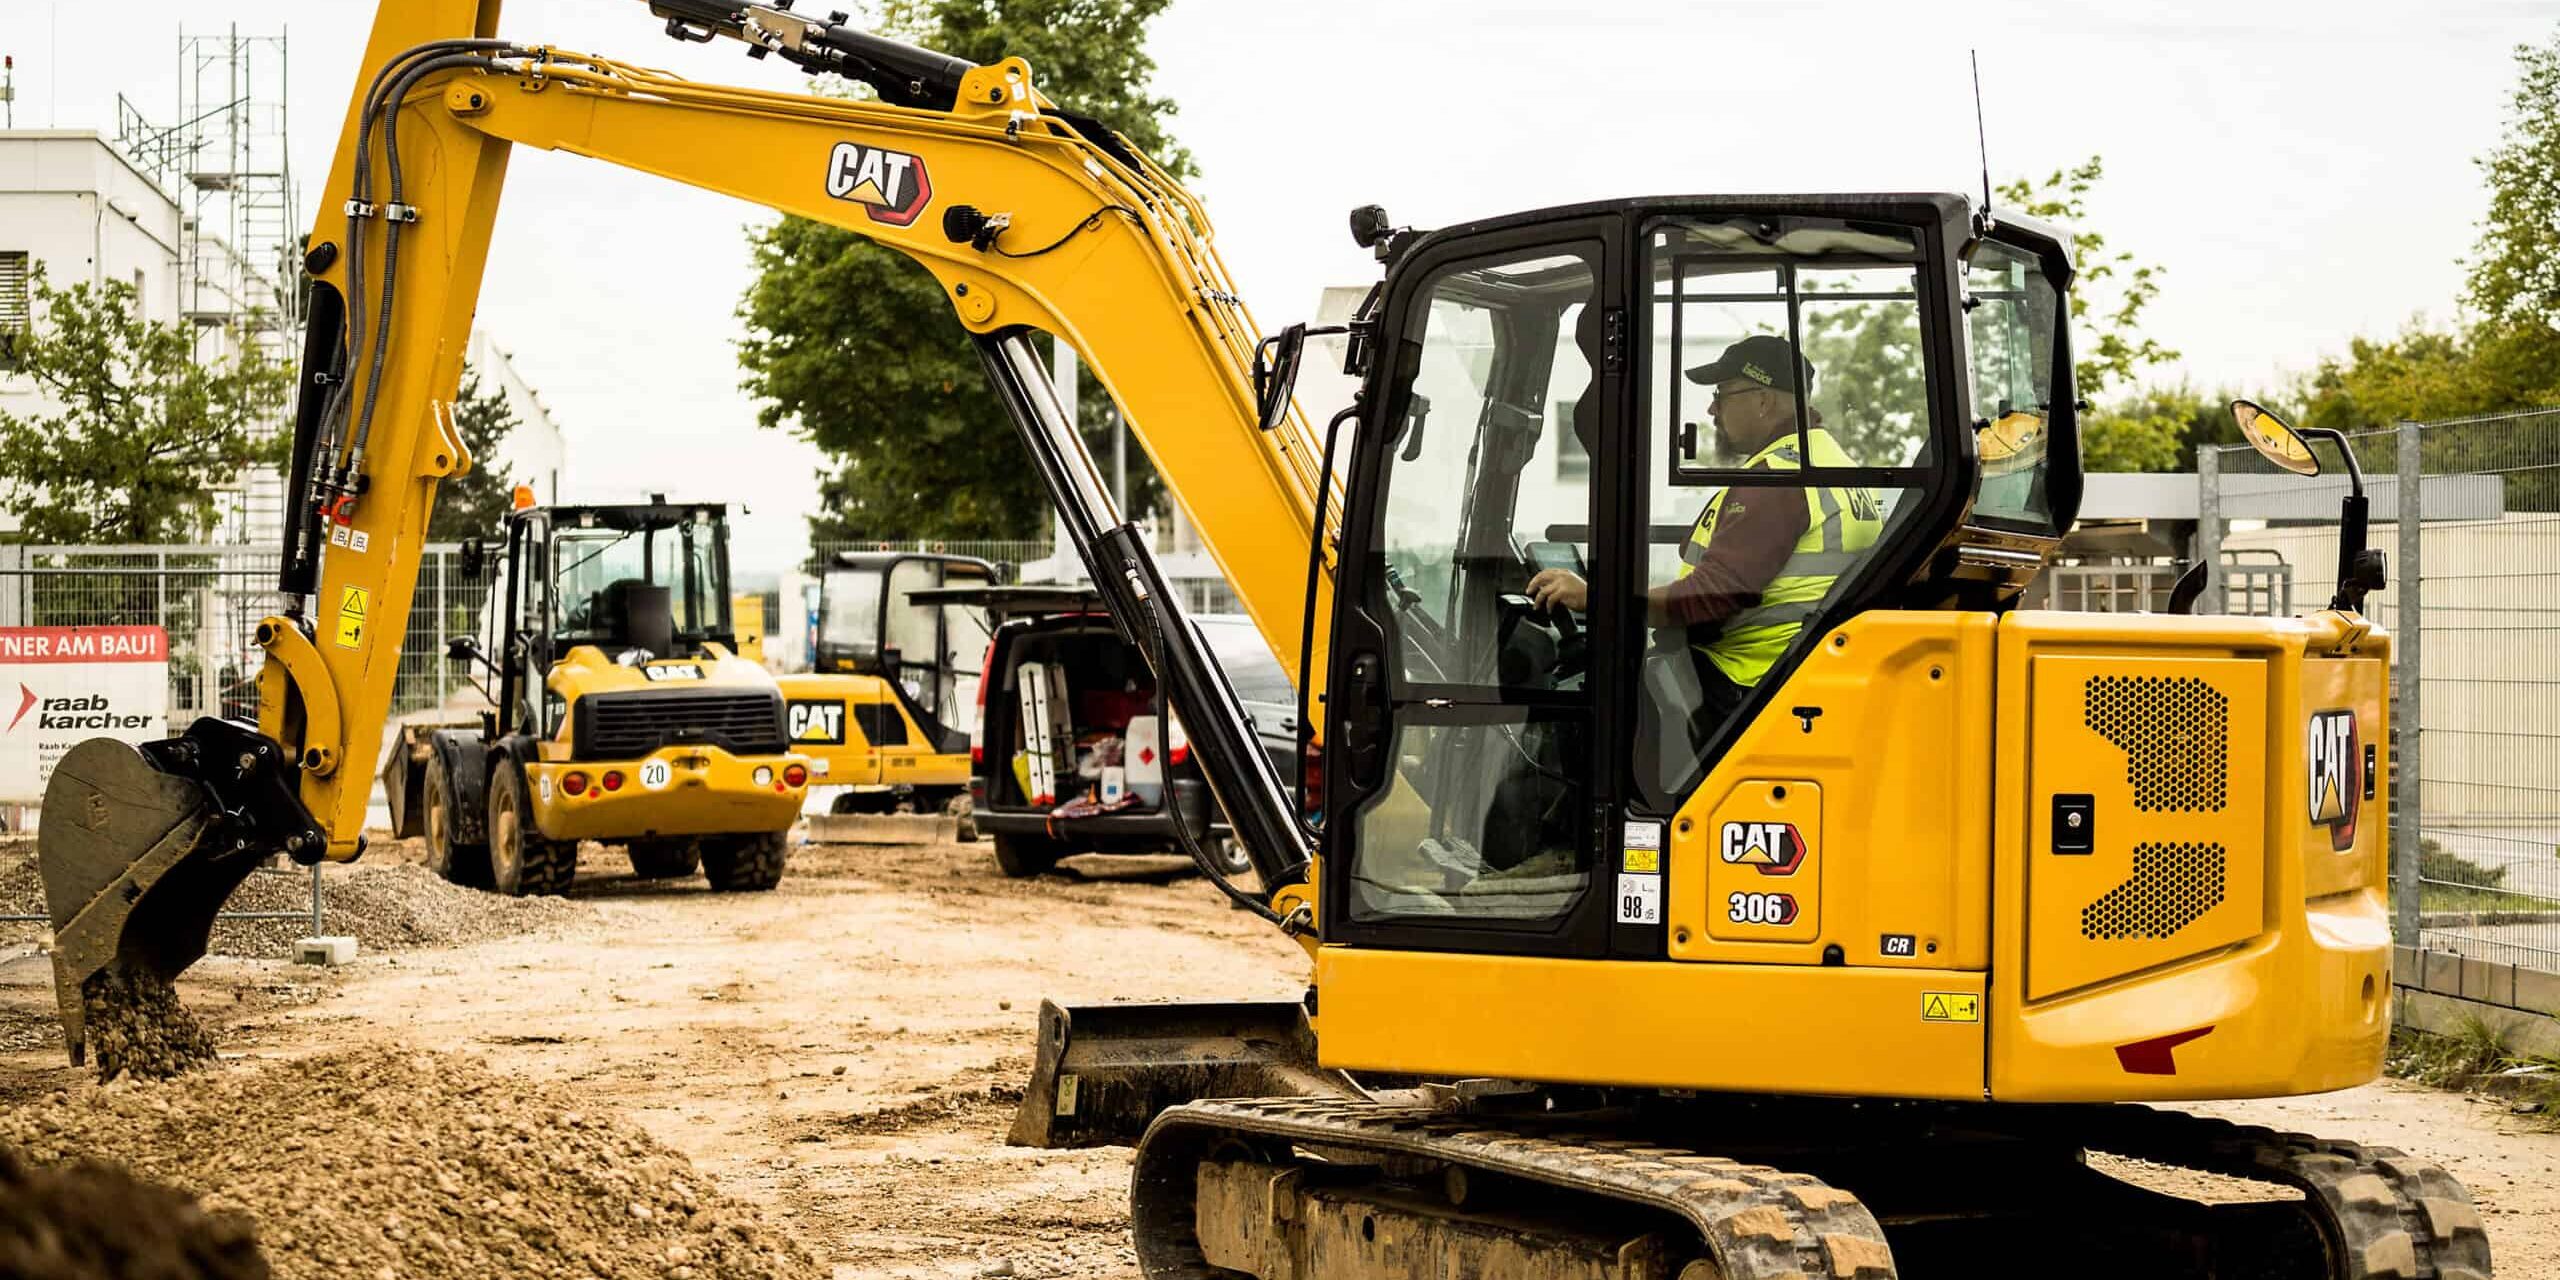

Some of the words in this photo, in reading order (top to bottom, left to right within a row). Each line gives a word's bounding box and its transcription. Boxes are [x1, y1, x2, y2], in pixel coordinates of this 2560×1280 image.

[827, 142, 912, 208] CAT
[55, 635, 95, 655] AM
[101, 633, 156, 655] BAU!
[43, 694, 109, 711] raab
[39, 713, 153, 729] karcher
[789, 704, 842, 740] CAT
[646, 764, 665, 784] 20
[2309, 714, 2350, 821] CAT
[1722, 822, 1786, 863] CAT
[1623, 896, 1642, 918] 98
[1729, 893, 1782, 923] 306
[1887, 937, 1909, 954] CR
